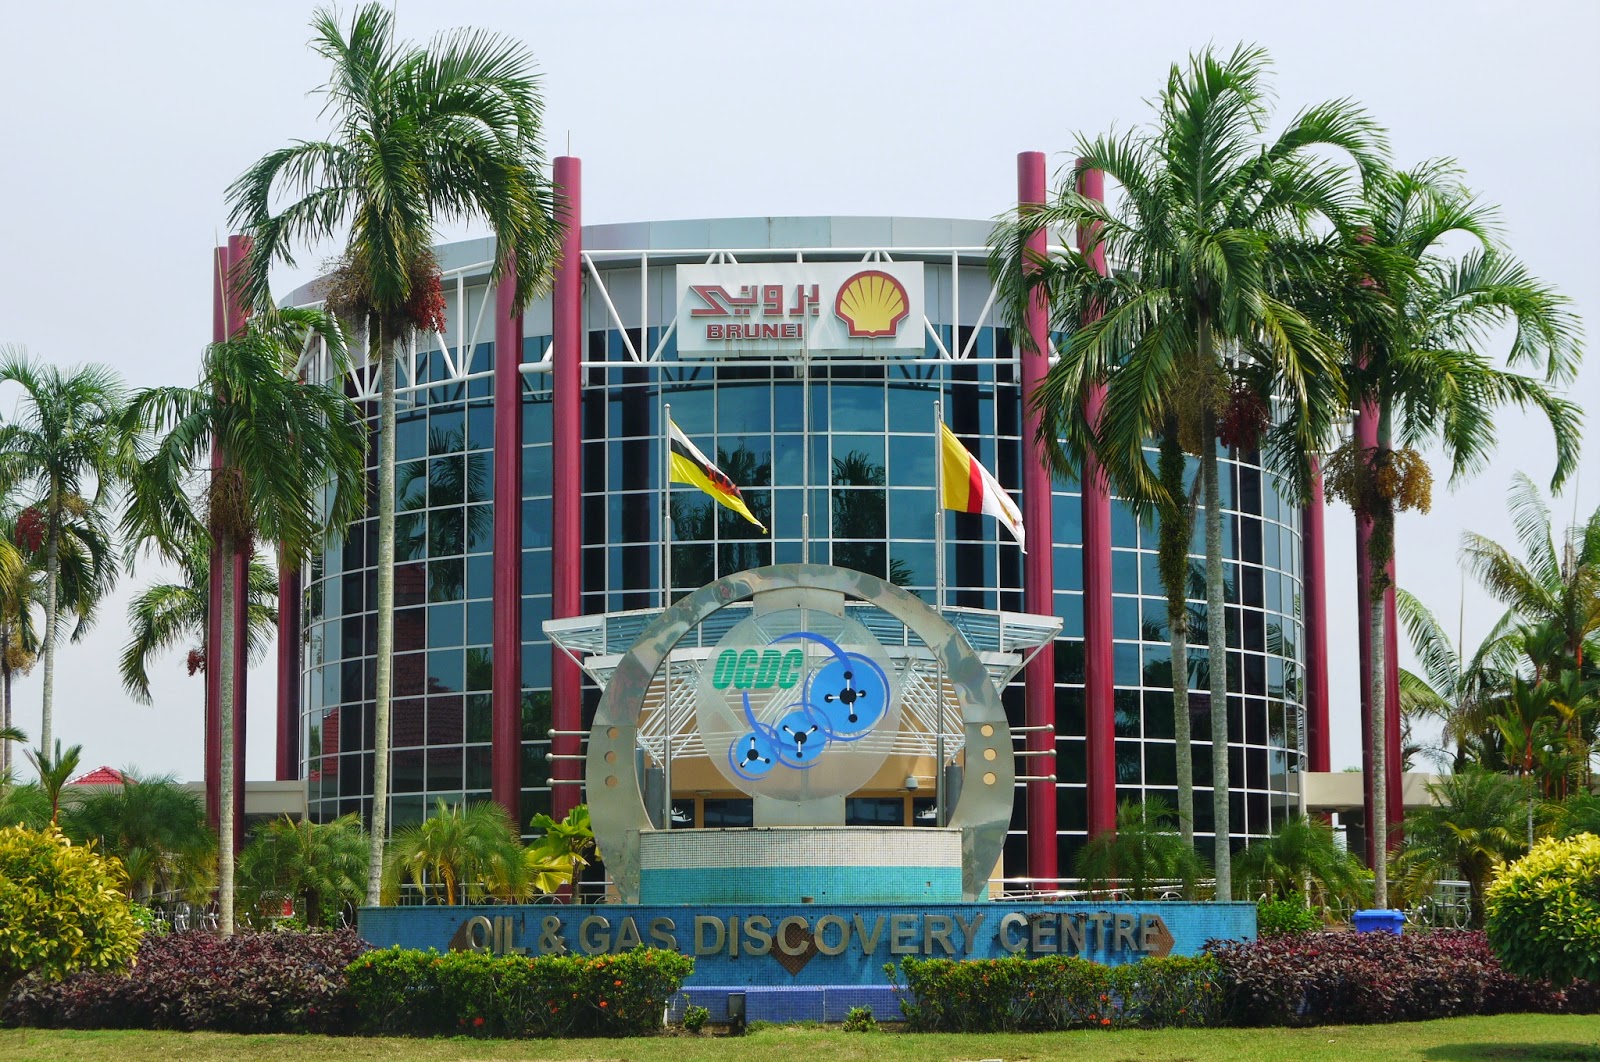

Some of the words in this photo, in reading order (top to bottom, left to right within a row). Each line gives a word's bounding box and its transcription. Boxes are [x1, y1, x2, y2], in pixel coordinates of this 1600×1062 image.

[706, 323, 803, 340] BRUNEI
[712, 648, 804, 690] OGDC
[465, 915, 526, 955] OIL
[538, 915, 567, 954] &
[578, 914, 677, 955] GAS
[694, 914, 984, 956] DISCOVERY
[999, 912, 1162, 952] CENTRE
